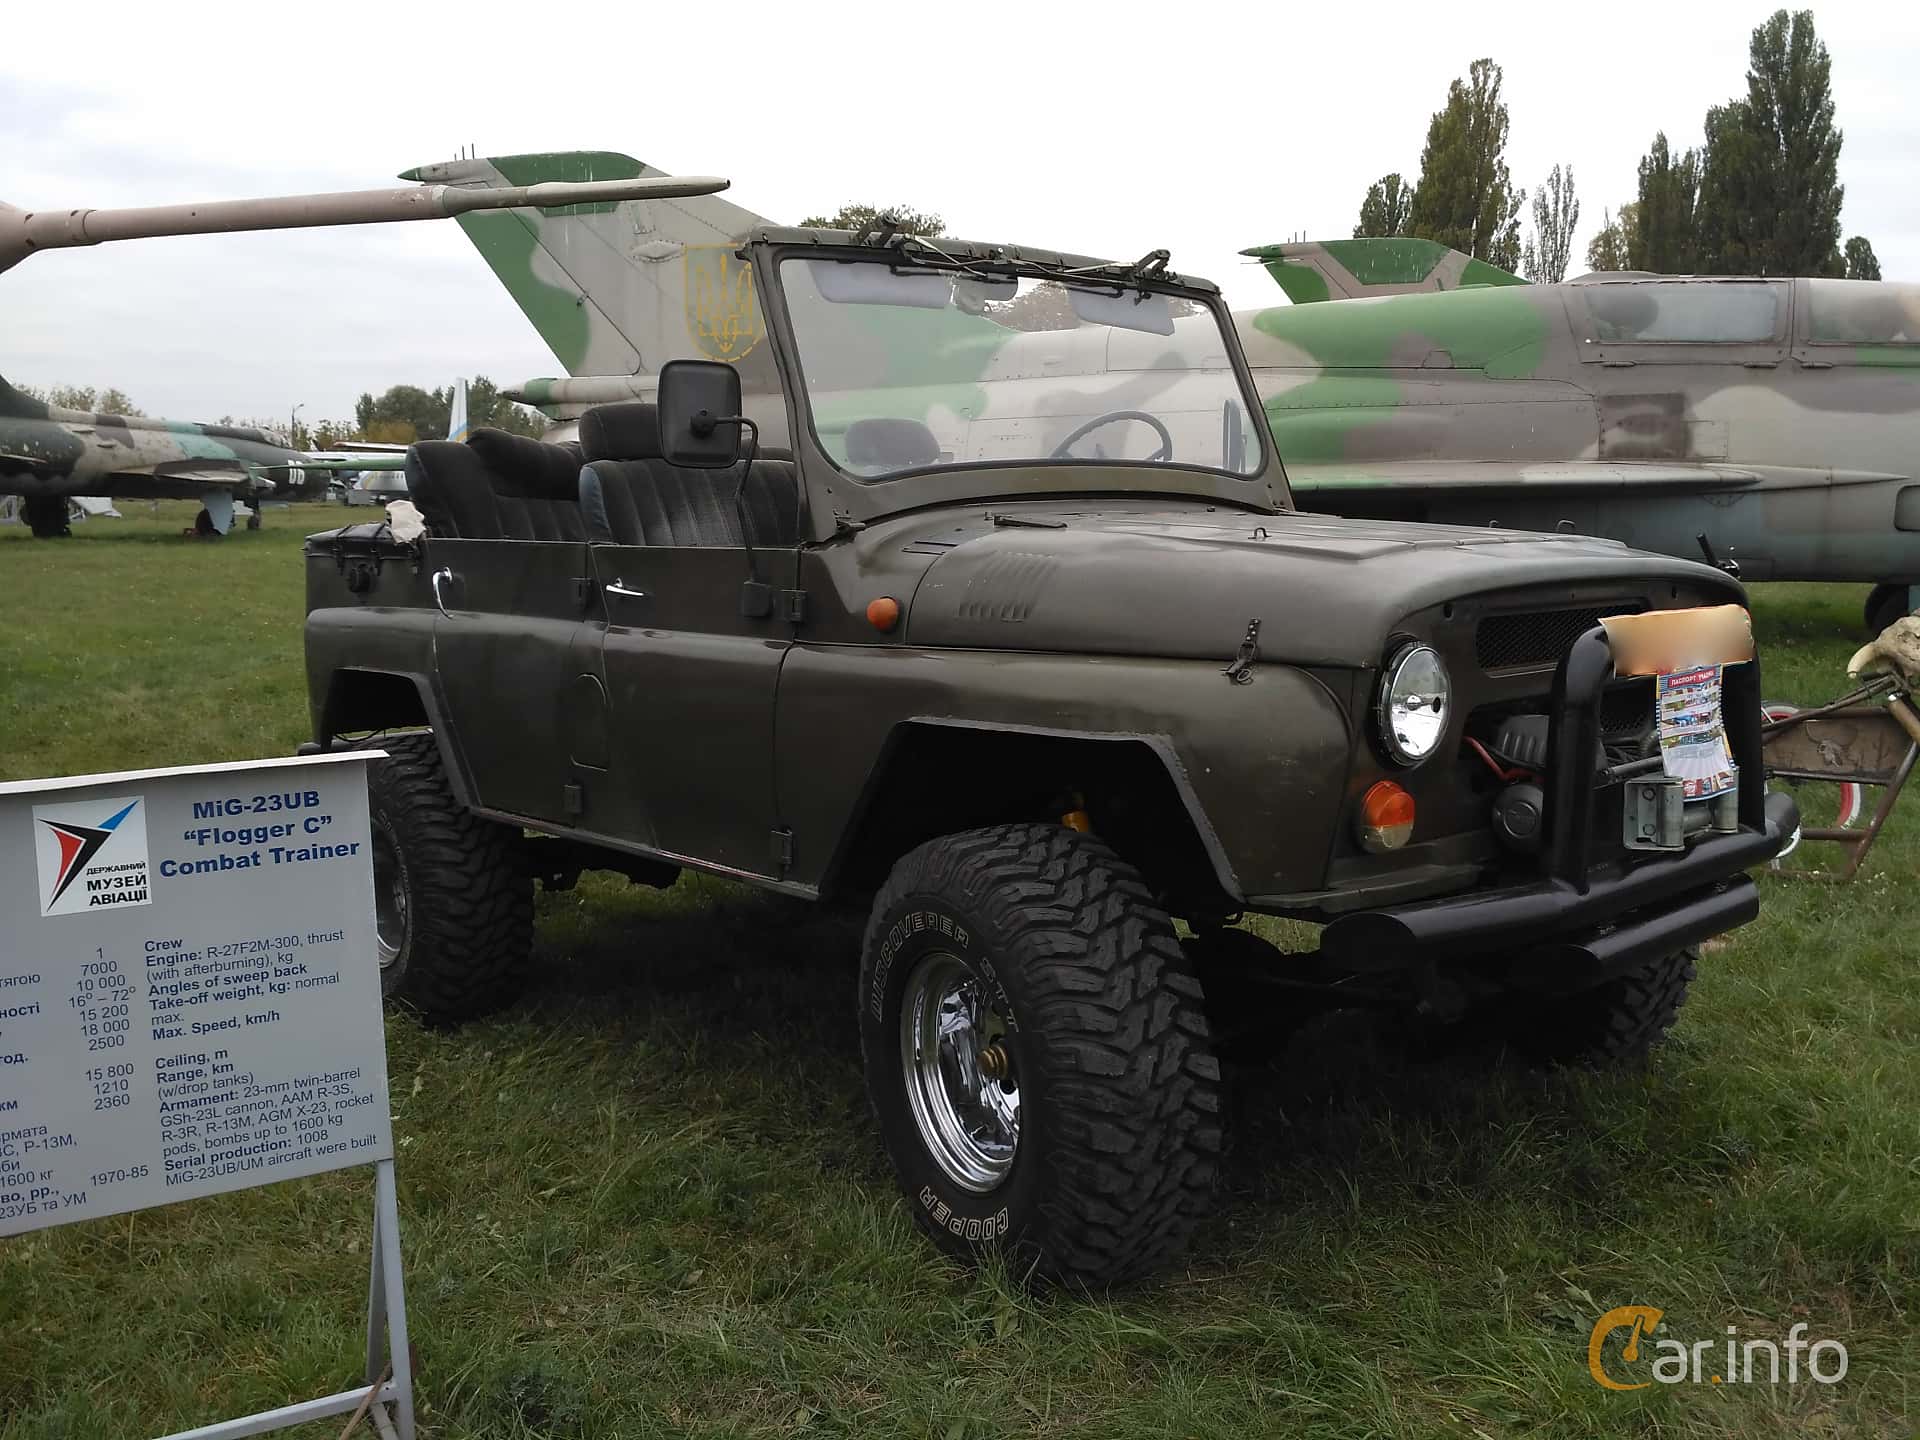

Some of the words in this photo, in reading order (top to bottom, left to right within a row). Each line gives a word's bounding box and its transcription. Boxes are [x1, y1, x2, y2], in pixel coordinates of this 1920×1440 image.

[193, 791, 320, 819] MiG-23UB
[184, 823, 295, 846] “Flogger
[303, 815, 332, 834] C”
[86, 861, 146, 876] ДЕРЖАВНИЙ
[160, 851, 261, 877] Combat
[269, 843, 360, 864] Trainer
[87, 872, 147, 891] МУЗЕЙ
[89, 887, 147, 906] АВІАЦІЇ
[97, 947, 103, 959] 1
[144, 938, 183, 952] Crew
[146, 951, 202, 967] Engine:
[207, 935, 304, 959] R-27F2M-300,
[308, 929, 345, 945] thrust
[81, 961, 117, 976] 7000
[147, 967, 180, 984] (with
[184, 956, 273, 977] afterburning),
[278, 952, 293, 964] kg
[871, 912, 969, 1023] DISCOVERER
[77, 979, 93, 992] 10
[98, 974, 126, 989] 000
[149, 979, 200, 997] Angles
[205, 976, 221, 989] of
[224, 971, 270, 983] sweep
[274, 963, 308, 978] back
[149, 991, 209, 1011] Take-off
[213, 984, 265, 1001] weight,
[269, 981, 291, 994] kg:
[295, 972, 340, 989] normal
[80, 1009, 97, 1022] 15
[102, 1004, 129, 1019] 200
[151, 1013, 184, 1026] max.
[81, 1023, 98, 1037] 18
[103, 1019, 130, 1034] 000
[153, 1026, 187, 1040] Max.
[192, 1017, 241, 1035] Speed,
[245, 1010, 280, 1026] km/h
[89, 1035, 125, 1051] 2500
[155, 1052, 210, 1070] Ceiling,
[215, 1049, 228, 1059] m
[86, 1068, 103, 1082] 15
[107, 1063, 135, 1078] 800
[157, 1068, 207, 1084] Range,
[212, 1062, 234, 1074] km
[94, 1079, 129, 1095] 1210
[158, 1079, 209, 1100] (w/drop
[213, 1071, 254, 1089] tanks)
[160, 1092, 239, 1113] Armament:
[243, 1082, 290, 1098] 23-mm
[294, 1068, 360, 1088] twin-barrel
[95, 1094, 130, 1110] 2360
[161, 1108, 221, 1127] GSh-23L
[225, 1099, 277, 1116] cannon,
[281, 1090, 313, 1105] AAM
[317, 1083, 354, 1099] R-3S,
[162, 1126, 201, 1142] R-3R,
[206, 1116, 254, 1134] R-13M,
[258, 1108, 292, 1124] AGM
[296, 1101, 331, 1117] X-23,
[335, 1093, 374, 1110] rocket
[0, 1126, 48, 1145] рмата
[163, 1142, 199, 1160] pods,
[205, 1132, 250, 1149] bombs
[254, 1128, 271, 1141] up
[275, 1124, 287, 1136] to
[292, 1118, 323, 1131] 1600
[328, 1114, 343, 1126] kg
[164, 1155, 206, 1171] Serial
[210, 1139, 291, 1161] production:
[297, 1130, 328, 1145] 1008
[166, 1157, 264, 1187] MiG-23UB/UM
[268, 1147, 312, 1166] aircraft
[316, 1142, 347, 1156] were
[350, 1134, 377, 1148] built
[0, 1160, 20, 1172] би
[90, 1165, 149, 1187] 1970-85
[0, 1171, 35, 1188] 1600
[40, 1170, 54, 1181] кг
[42, 1201, 58, 1211] та
[63, 1192, 87, 1208] УМ
[919, 1186, 1009, 1240] COOPER
